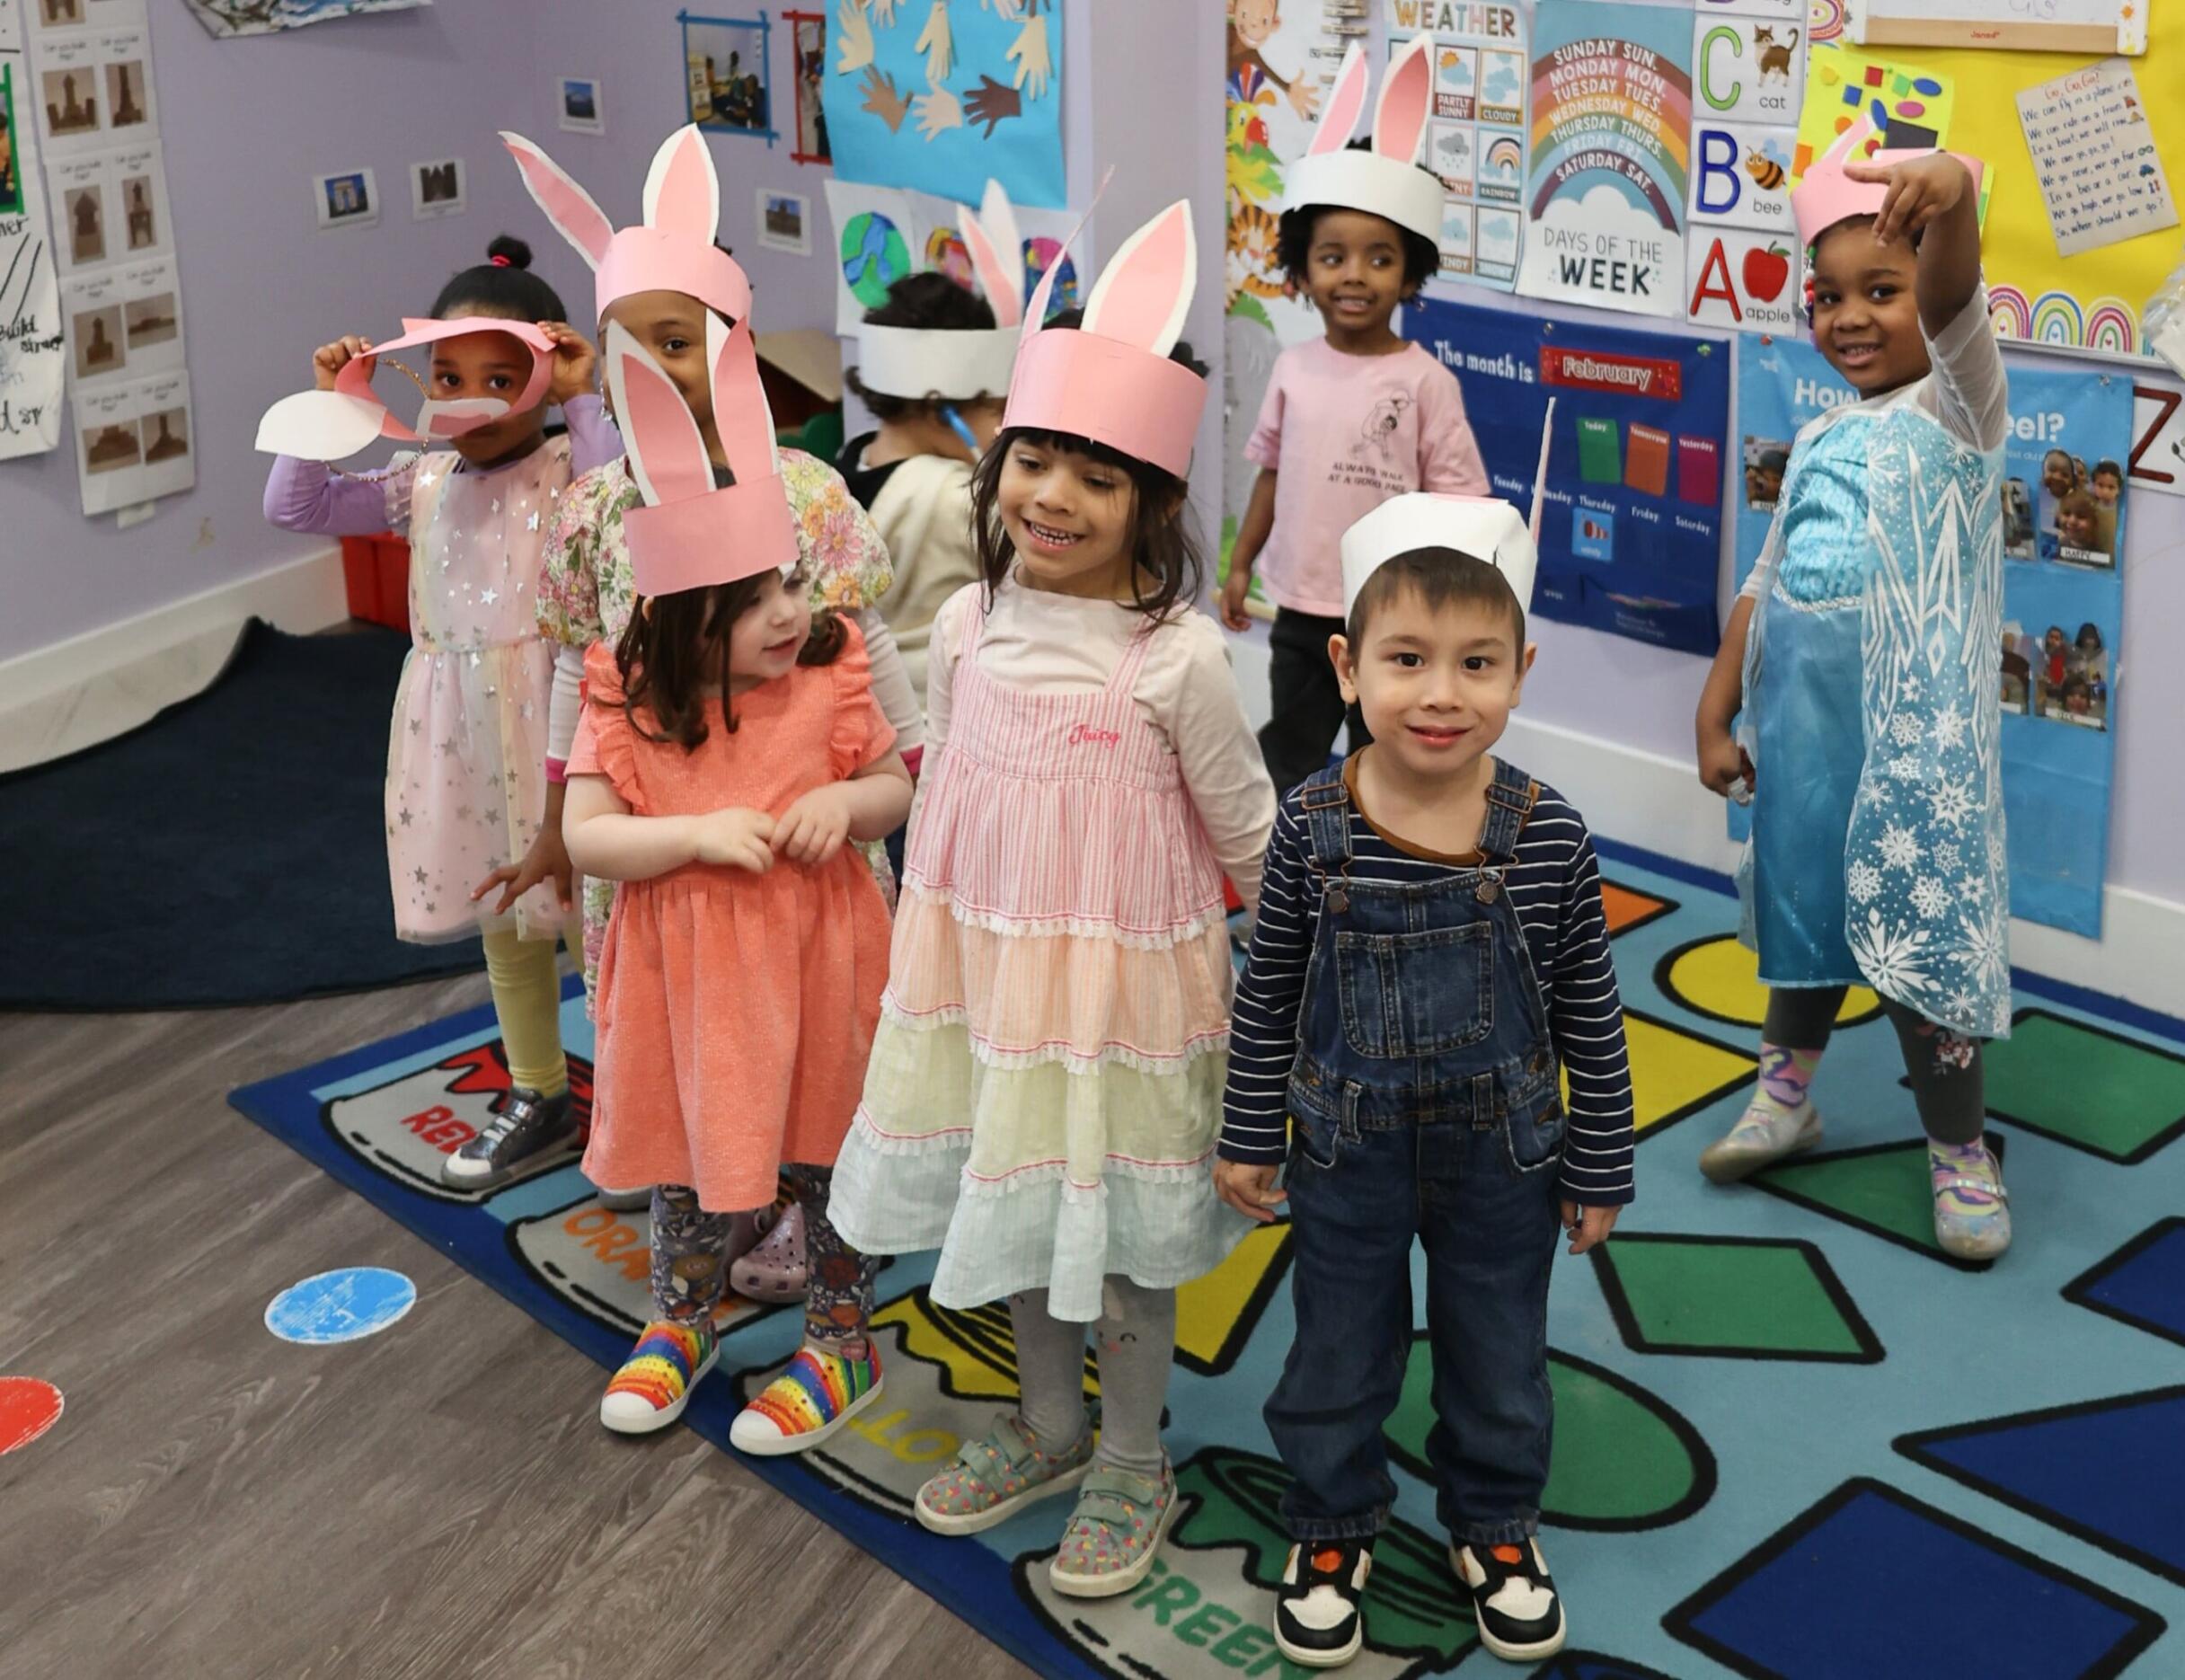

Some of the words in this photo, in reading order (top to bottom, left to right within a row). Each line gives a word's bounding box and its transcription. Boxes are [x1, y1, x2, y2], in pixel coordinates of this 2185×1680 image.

[1393, 0, 1516, 38] WEATHER
[1553, 40, 1616, 66] SUNDAY
[1623, 43, 1658, 70] SUN.
[1700, 25, 1742, 111] C
[1550, 59, 1618, 88] MONDAY
[1624, 64, 1666, 98] MON.
[1438, 95, 1469, 108] PARTLY
[1552, 78, 1617, 103] TUESDAY
[1624, 83, 1662, 115] TUES.
[1759, 94, 1786, 110] cat
[1438, 106, 1469, 118] SUNNY
[1482, 109, 1517, 121] CLOUDY
[1549, 97, 1627, 126] WEDNESDAY
[1632, 106, 1661, 137] WED.
[2022, 109, 2039, 122] We
[1550, 116, 1615, 144] THURSDAY
[1621, 120, 1661, 159] THURS.
[2027, 128, 2041, 140] We
[1563, 135, 1613, 155] FRIDAY
[1617, 138, 1644, 164] FRI.
[2042, 156, 2056, 170] We
[1555, 153, 1622, 182] SATURDAY
[1625, 164, 1652, 195] SAT.
[1695, 129, 1741, 215] B
[2040, 174, 2055, 189] We
[1481, 187, 1517, 200] RAINBOW
[1753, 198, 1782, 216] bee
[2052, 208, 2066, 221] We
[1544, 226, 1588, 253] DAYS
[1596, 234, 1618, 256] OF
[1626, 239, 1662, 263] THE
[1440, 255, 1469, 270] INDY
[1560, 253, 1650, 296] WEEK
[1690, 237, 1742, 323] A
[1746, 306, 1791, 324] apple
[1434, 340, 1464, 367] The
[1466, 353, 1516, 380] month
[1518, 361, 1535, 384] is
[1562, 356, 1651, 392] February
[1585, 420, 1607, 433] Today
[2127, 386, 2182, 484] Z
[1678, 438, 1714, 453] Yesterday
[1343, 476, 1350, 484] A
[1493, 474, 1524, 493] Tuesday
[1579, 495, 1617, 514] Thursday
[1632, 506, 1659, 523] Friday
[1675, 515, 1711, 536] Saturday
[1068, 723, 1121, 751] Juicy
